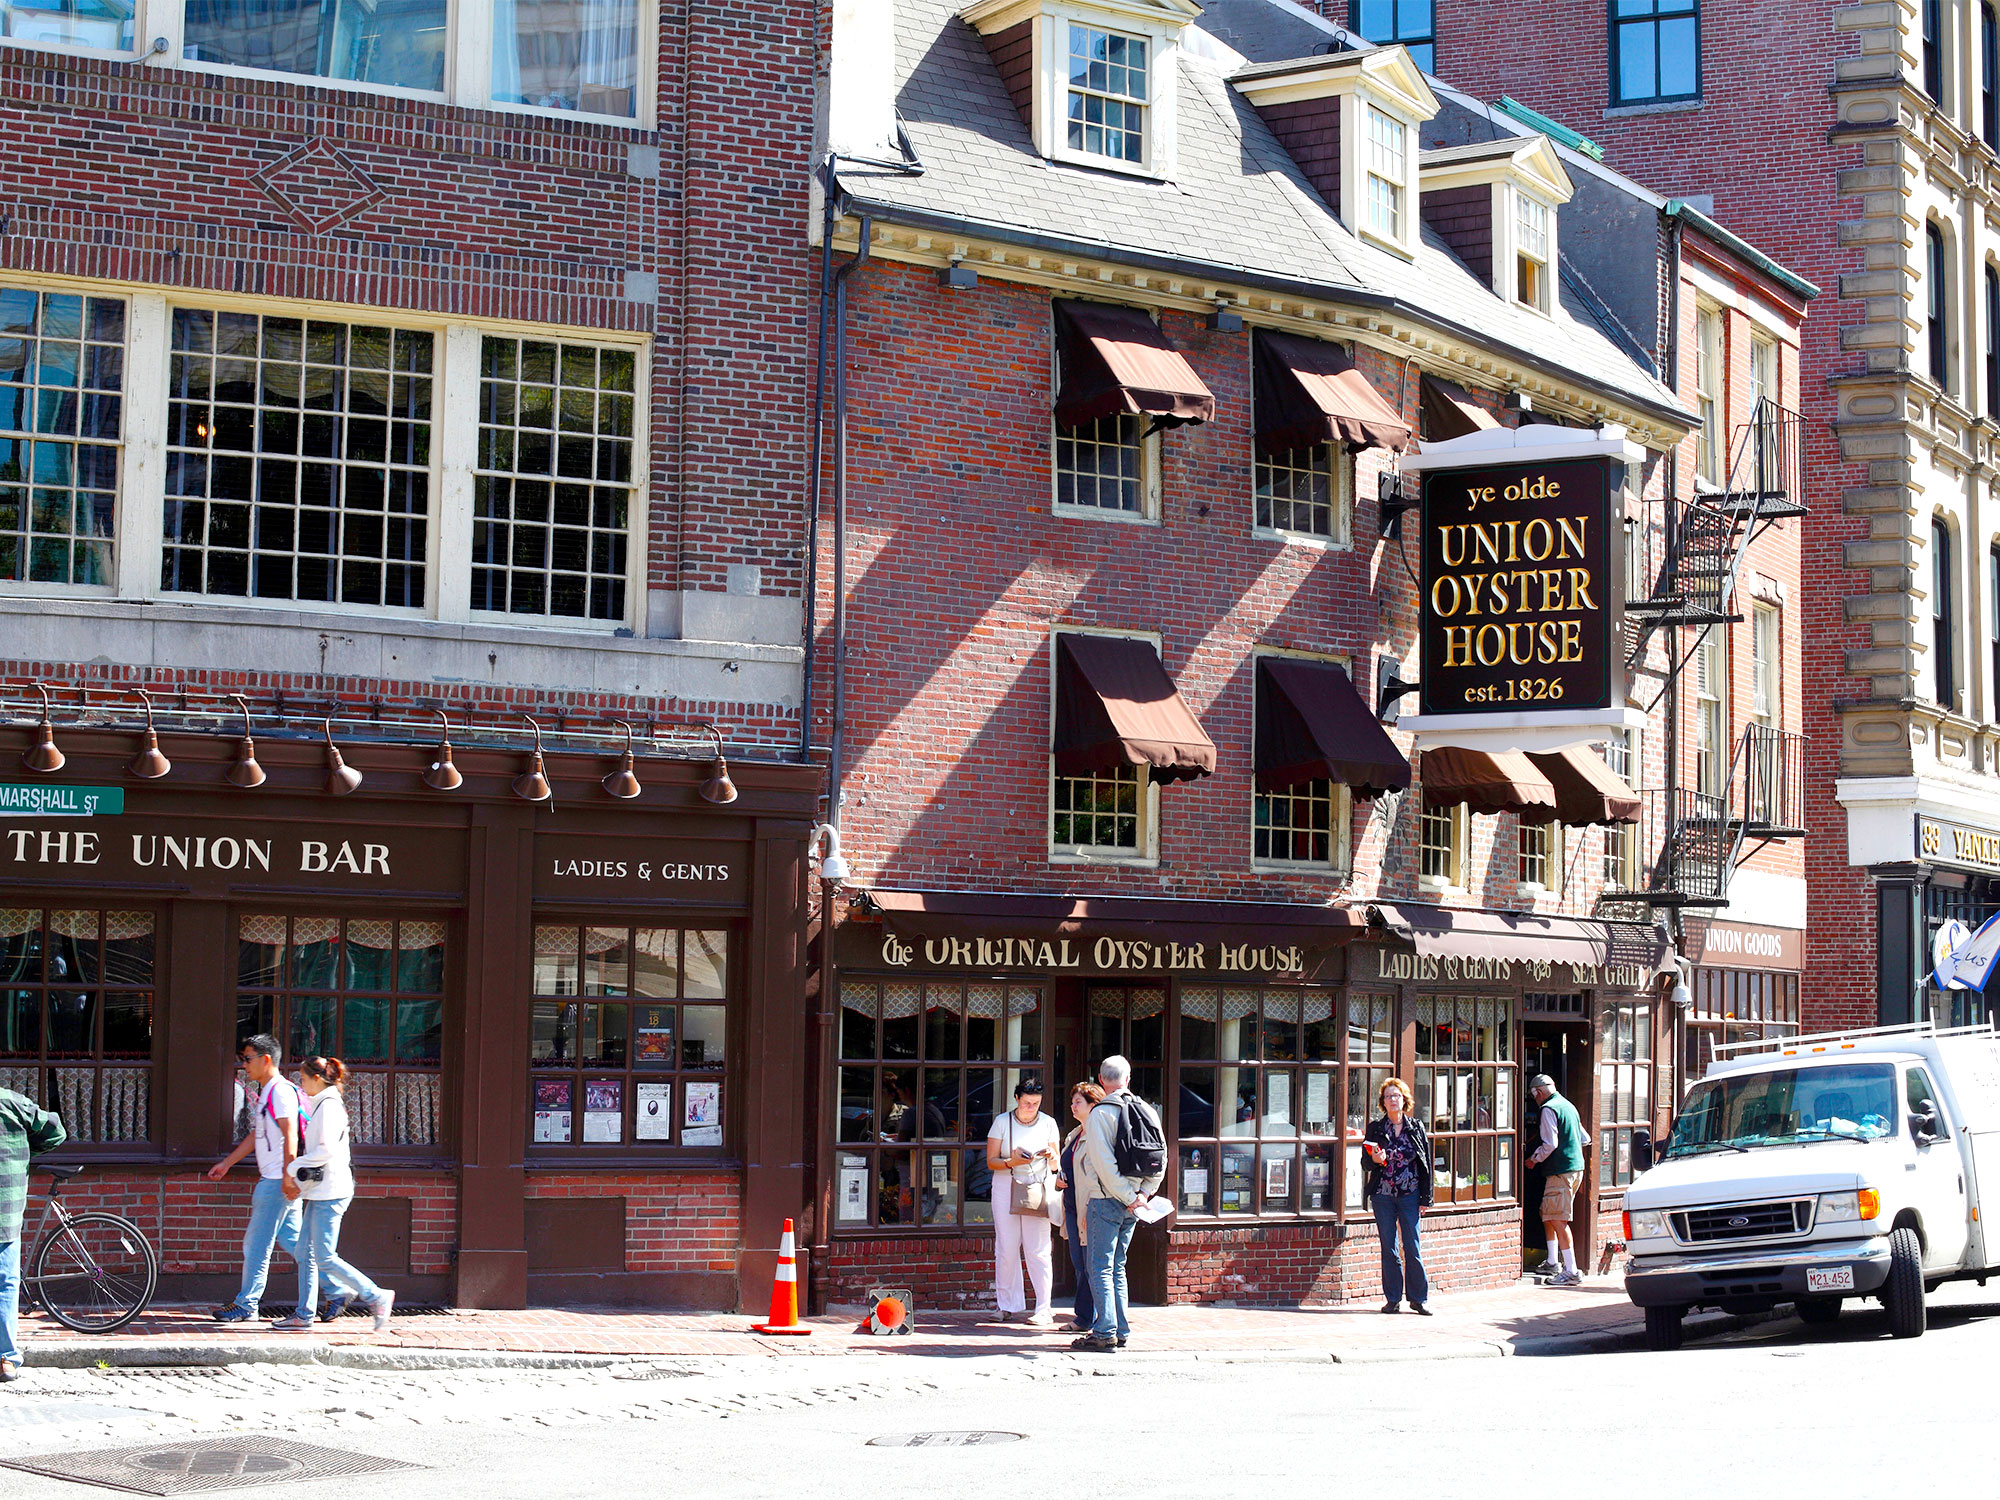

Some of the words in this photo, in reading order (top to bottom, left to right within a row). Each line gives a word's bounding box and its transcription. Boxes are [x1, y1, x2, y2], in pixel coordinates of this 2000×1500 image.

[1467, 485, 1496, 511] ye
[1504, 475, 1561, 501] olde
[1438, 516, 1589, 567] UNION
[1431, 567, 1599, 617] OYSTER
[1442, 619, 1584, 667] HOUSE
[0, 787, 78, 809] MARSHALL
[84, 795, 99, 810] ST
[7, 829, 101, 865] THE
[131, 834, 272, 872] UNION
[299, 840, 391, 875] BAR
[1953, 828, 2000, 866] YANKE
[553, 859, 628, 878] LADIES
[637, 862, 652, 881] &
[662, 863, 729, 881] GENTS
[881, 933, 914, 967] The
[925, 936, 1080, 967] ORIGINAL
[1094, 936, 1206, 969] OYSTER
[1218, 942, 1304, 972] HOUSE
[1705, 928, 1742, 953] UNION
[1744, 932, 1782, 957] GOODS
[1378, 949, 1439, 980] LADIES
[1444, 955, 1459, 980] &
[1462, 955, 1511, 980] GENTS
[1572, 961, 1599, 985] SEA
